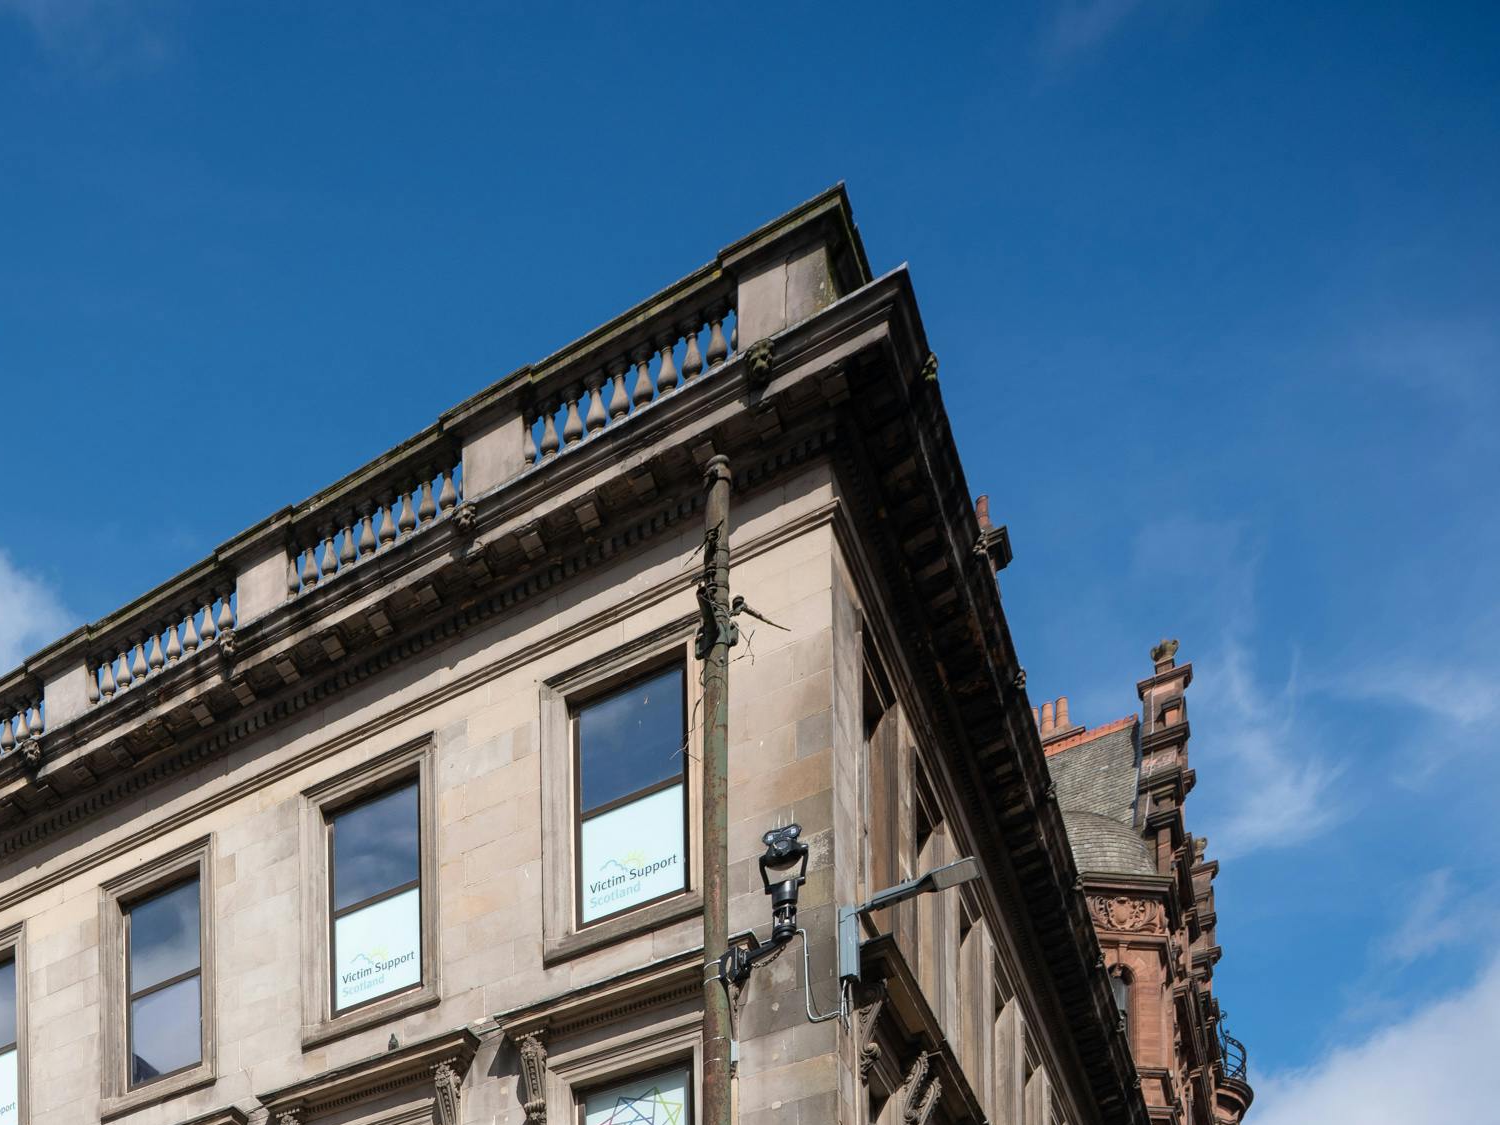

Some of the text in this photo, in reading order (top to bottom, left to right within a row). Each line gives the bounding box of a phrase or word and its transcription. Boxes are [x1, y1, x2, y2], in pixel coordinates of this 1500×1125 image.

[590, 853, 677, 894] Victim Support
[589, 881, 642, 908] Scotland
[342, 951, 415, 984] Victim Support
